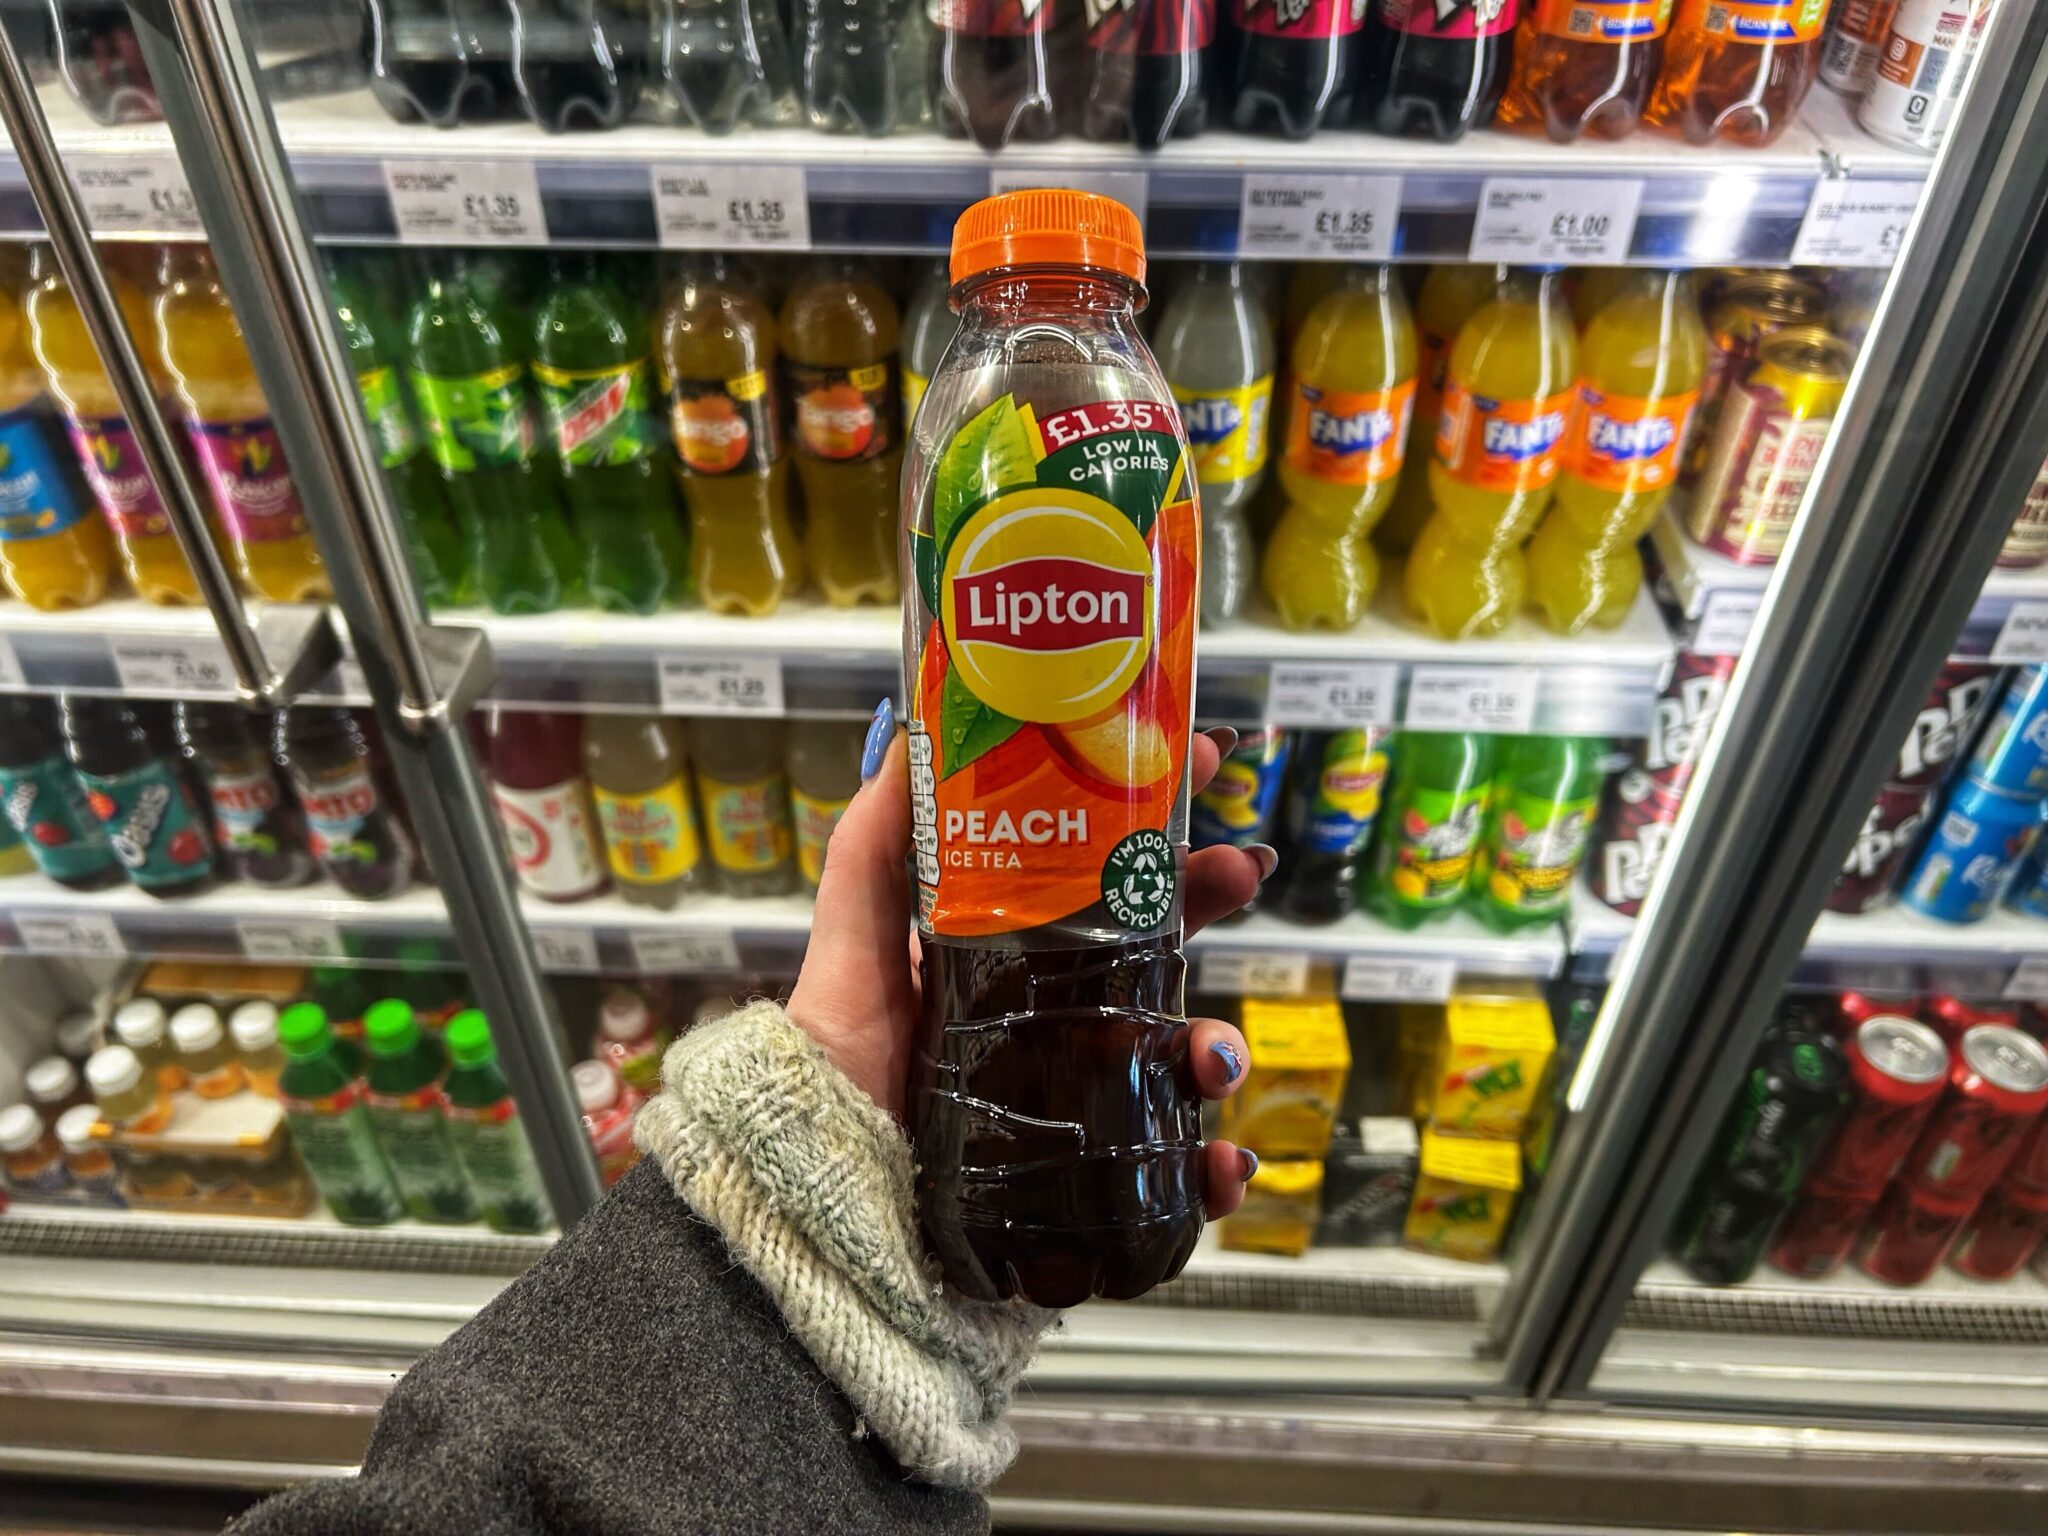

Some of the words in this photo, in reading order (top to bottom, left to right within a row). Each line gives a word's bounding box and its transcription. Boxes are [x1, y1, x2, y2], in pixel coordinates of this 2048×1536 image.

[728, 200, 785, 222] £1.35
[1315, 211, 1374, 234] £1.35
[1551, 213, 1611, 237] £1.00
[1082, 439, 1132, 460] LOW
[1137, 439, 1158, 453] IN
[1069, 456, 1169, 481] CALORIES
[969, 581, 1129, 636] Lipton
[945, 808, 1088, 845] PEACH
[945, 850, 973, 867] ICE
[980, 851, 1022, 868] TEA
[1111, 840, 1135, 867] I'M
[1136, 833, 1170, 865] 100%
[1105, 873, 1174, 928] RECYCLABLE
